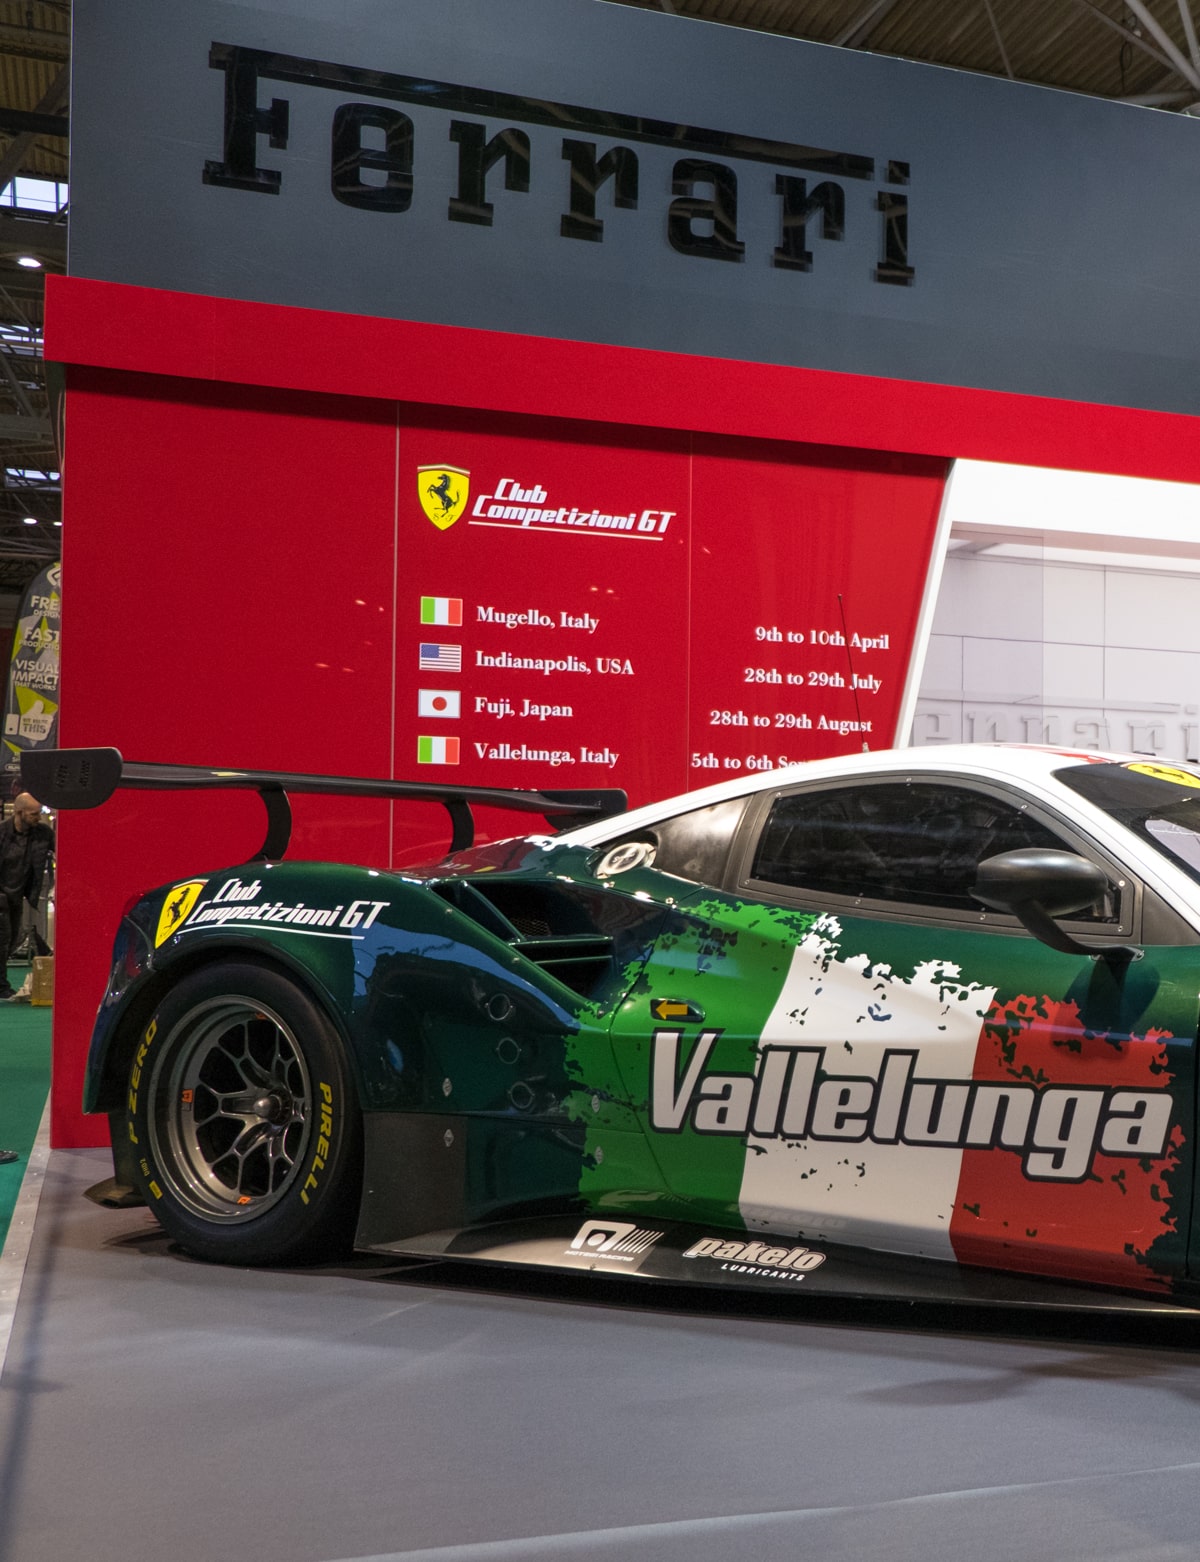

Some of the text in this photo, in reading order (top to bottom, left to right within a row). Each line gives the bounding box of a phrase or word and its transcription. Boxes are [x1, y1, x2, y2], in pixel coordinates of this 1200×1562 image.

[203, 41, 915, 286] Ferrari
[494, 479, 547, 504] Club
[472, 495, 676, 533] Competizioni GT
[31, 595, 60, 611] FRE
[476, 606, 600, 634] Mugello, Italy
[755, 626, 890, 652] 9th to 10th April
[15, 659, 59, 674] VISUAL
[475, 650, 634, 676] Indianapolis, USA
[12, 670, 59, 685] IMPACT
[32, 683, 57, 691] WORKS
[744, 667, 883, 694] 28th to 29th July
[474, 697, 573, 721] Fuji, Japan
[23, 723, 46, 734] THIS
[710, 710, 873, 736] 28th to 29th August
[474, 742, 620, 769] Vallelunga, Italy
[691, 753, 719, 768] 5th
[724, 756, 741, 769] to
[746, 755, 774, 770] 6th
[213, 881, 262, 903] Club
[186, 900, 390, 929] Competizioni GT
[128, 1018, 158, 1115] ZERO
[648, 1027, 1175, 1183] Vallelunga
[300, 1082, 333, 1205] PIRELLI
[682, 1237, 827, 1271] pakelo
[721, 1263, 805, 1281] LUBRICANTS
